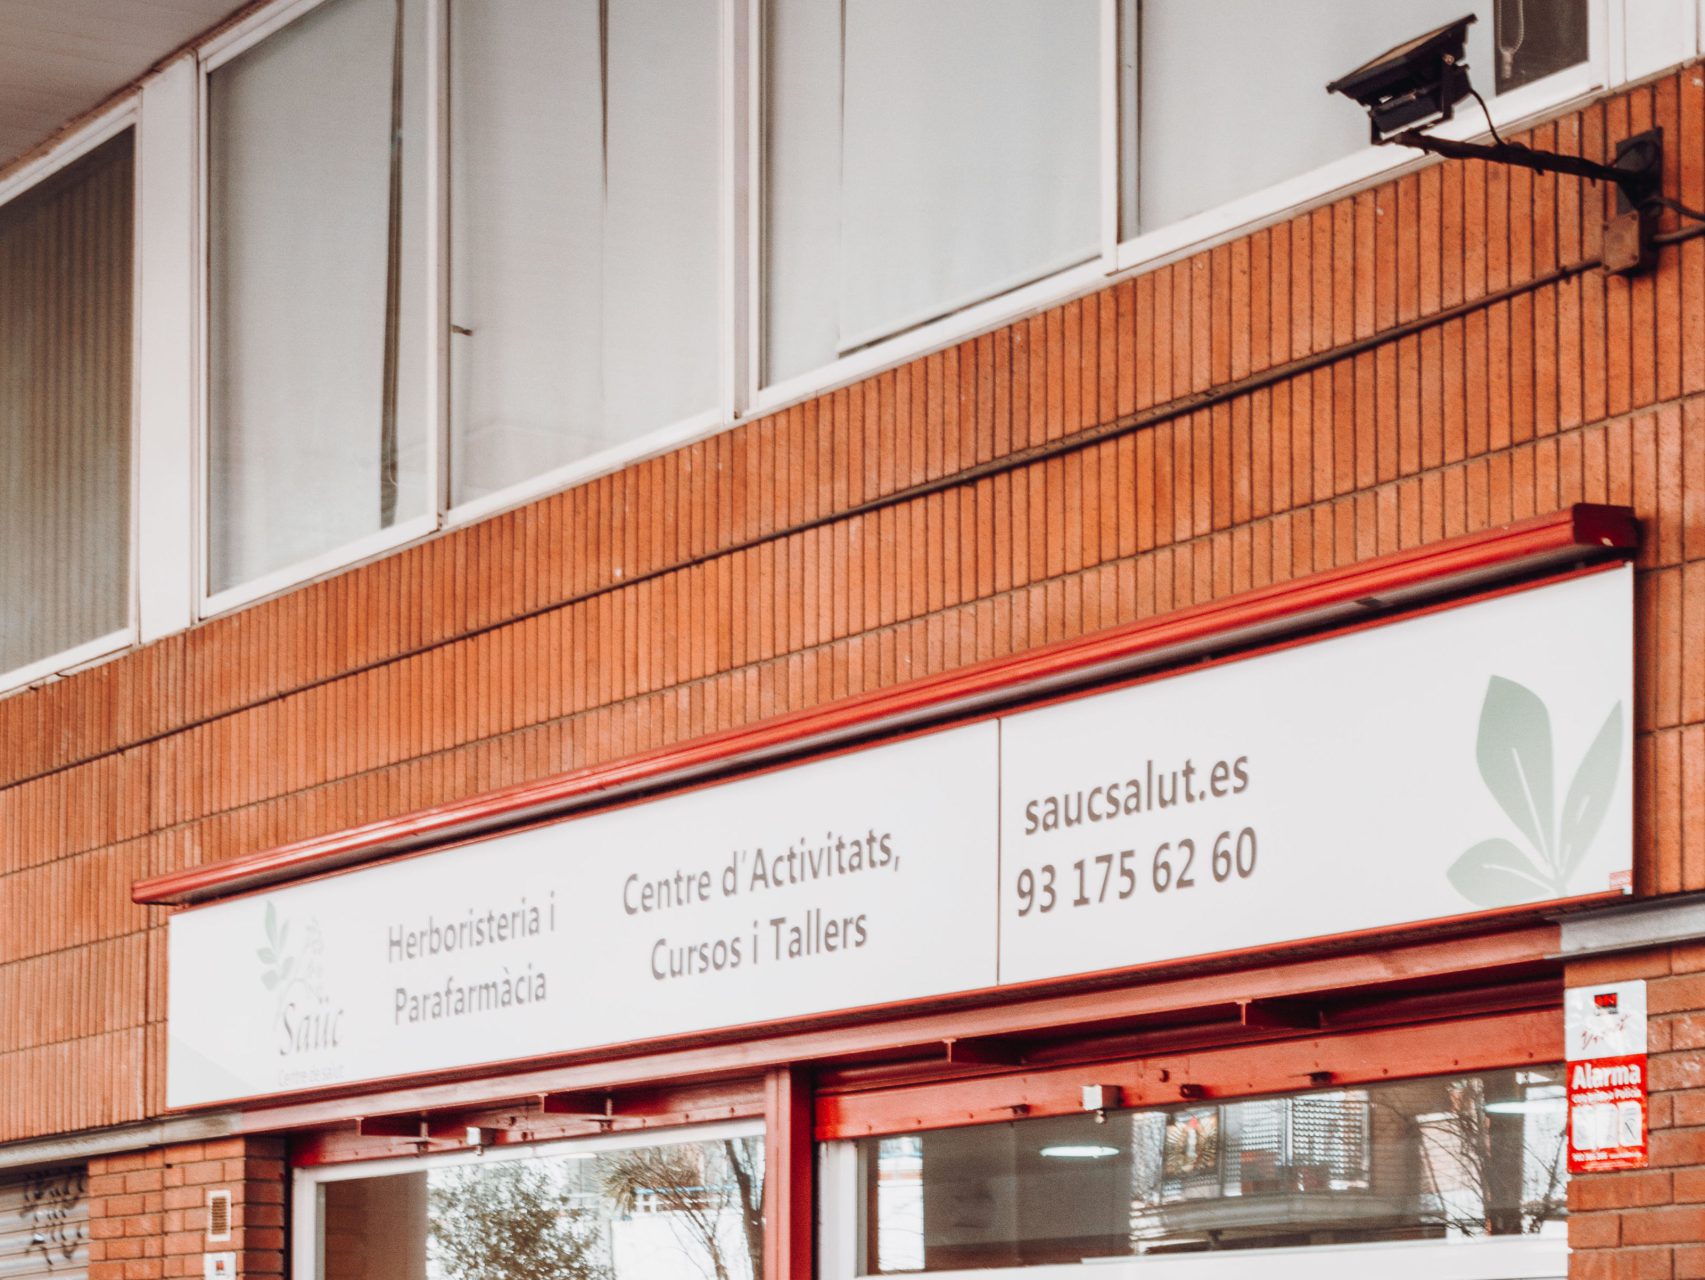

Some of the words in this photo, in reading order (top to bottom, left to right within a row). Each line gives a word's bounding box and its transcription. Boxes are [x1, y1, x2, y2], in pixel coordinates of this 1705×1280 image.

[1024, 754, 1251, 837] saucsalut.es
[622, 867, 713, 917] Centre
[721, 827, 901, 898] d'Activitats,
[1015, 862, 1058, 919] 93
[1072, 849, 1138, 908] 175
[1151, 837, 1197, 895] 62
[1211, 826, 1259, 885] 60
[387, 896, 542, 962] Herboristeria
[549, 890, 556, 932] i
[650, 935, 743, 982] Cursos
[752, 918, 760, 966] i
[769, 906, 869, 961] Tallers
[394, 962, 548, 1027] Parafarmàcia
[1572, 1062, 1641, 1090] Alarma
